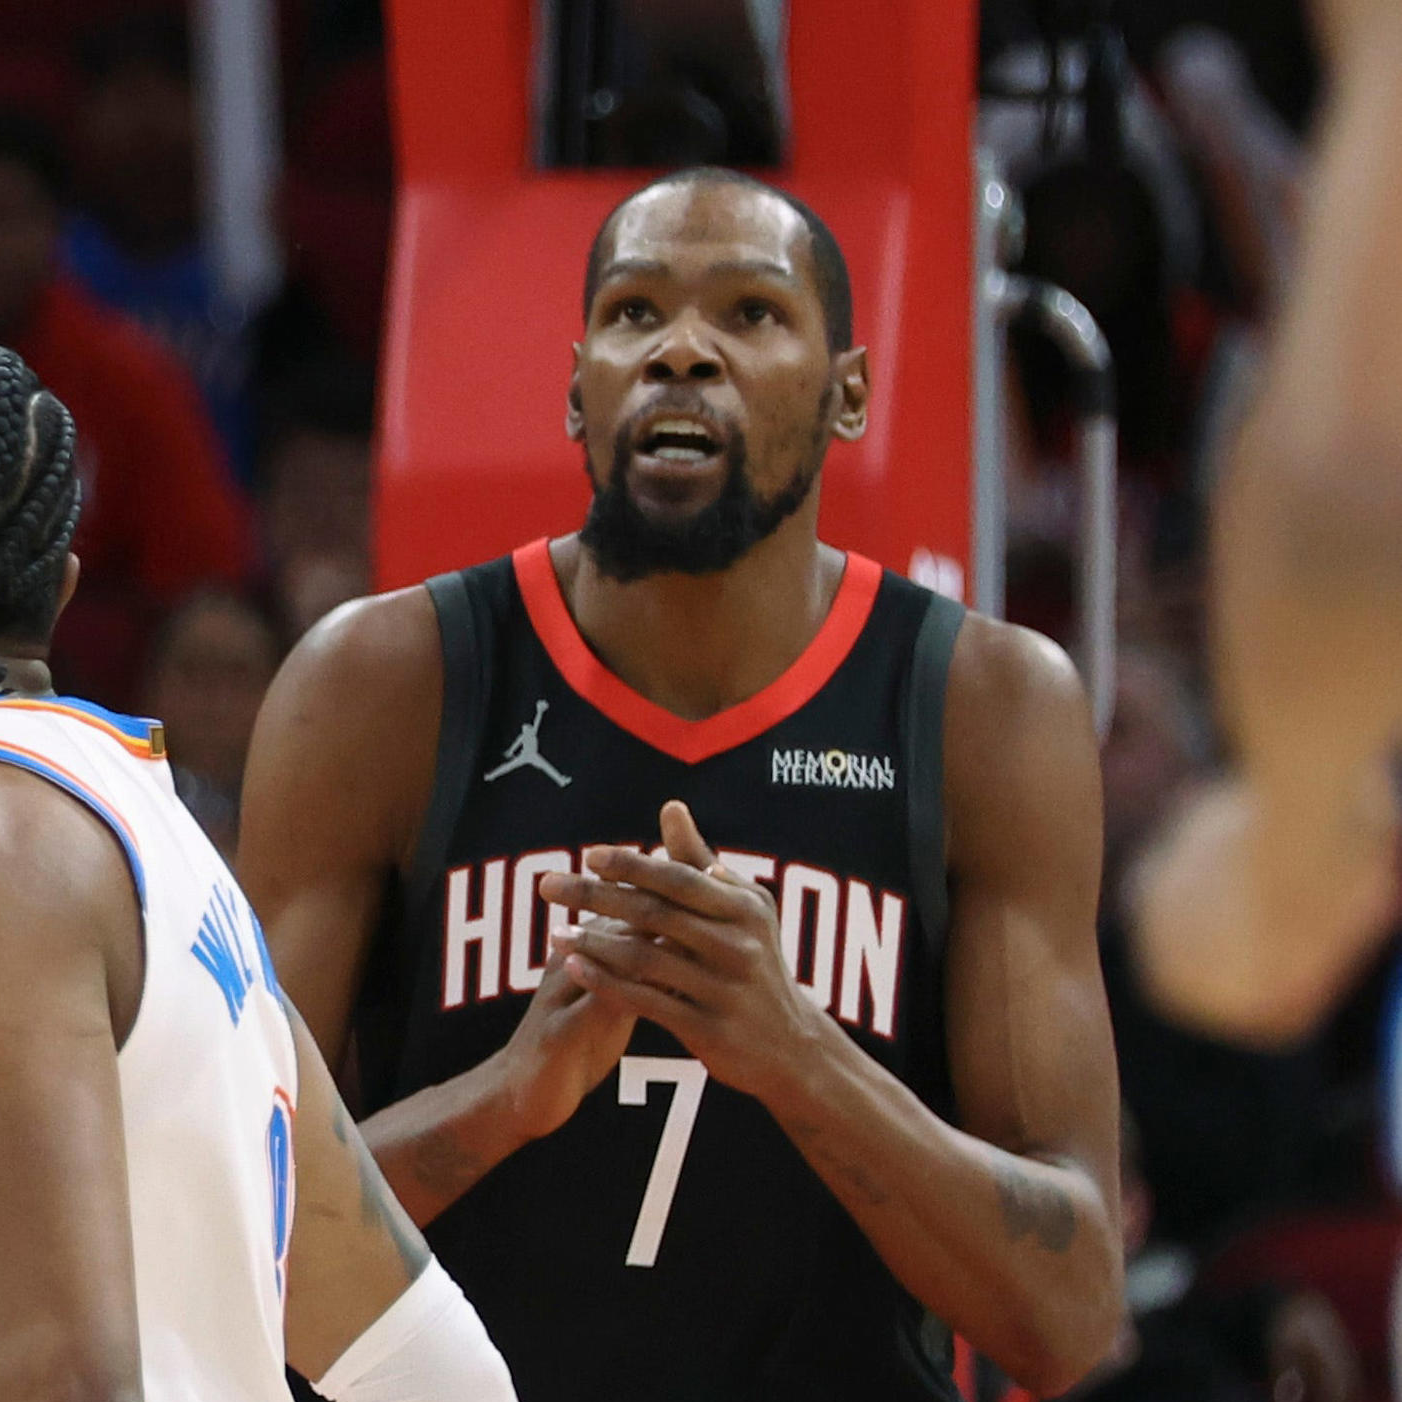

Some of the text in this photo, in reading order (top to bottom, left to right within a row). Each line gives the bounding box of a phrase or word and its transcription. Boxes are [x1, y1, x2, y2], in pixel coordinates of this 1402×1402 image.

[772, 748, 895, 775] MEMORIAL
[772, 764, 895, 791] HERMANN
[618, 1056, 708, 1268] 7
